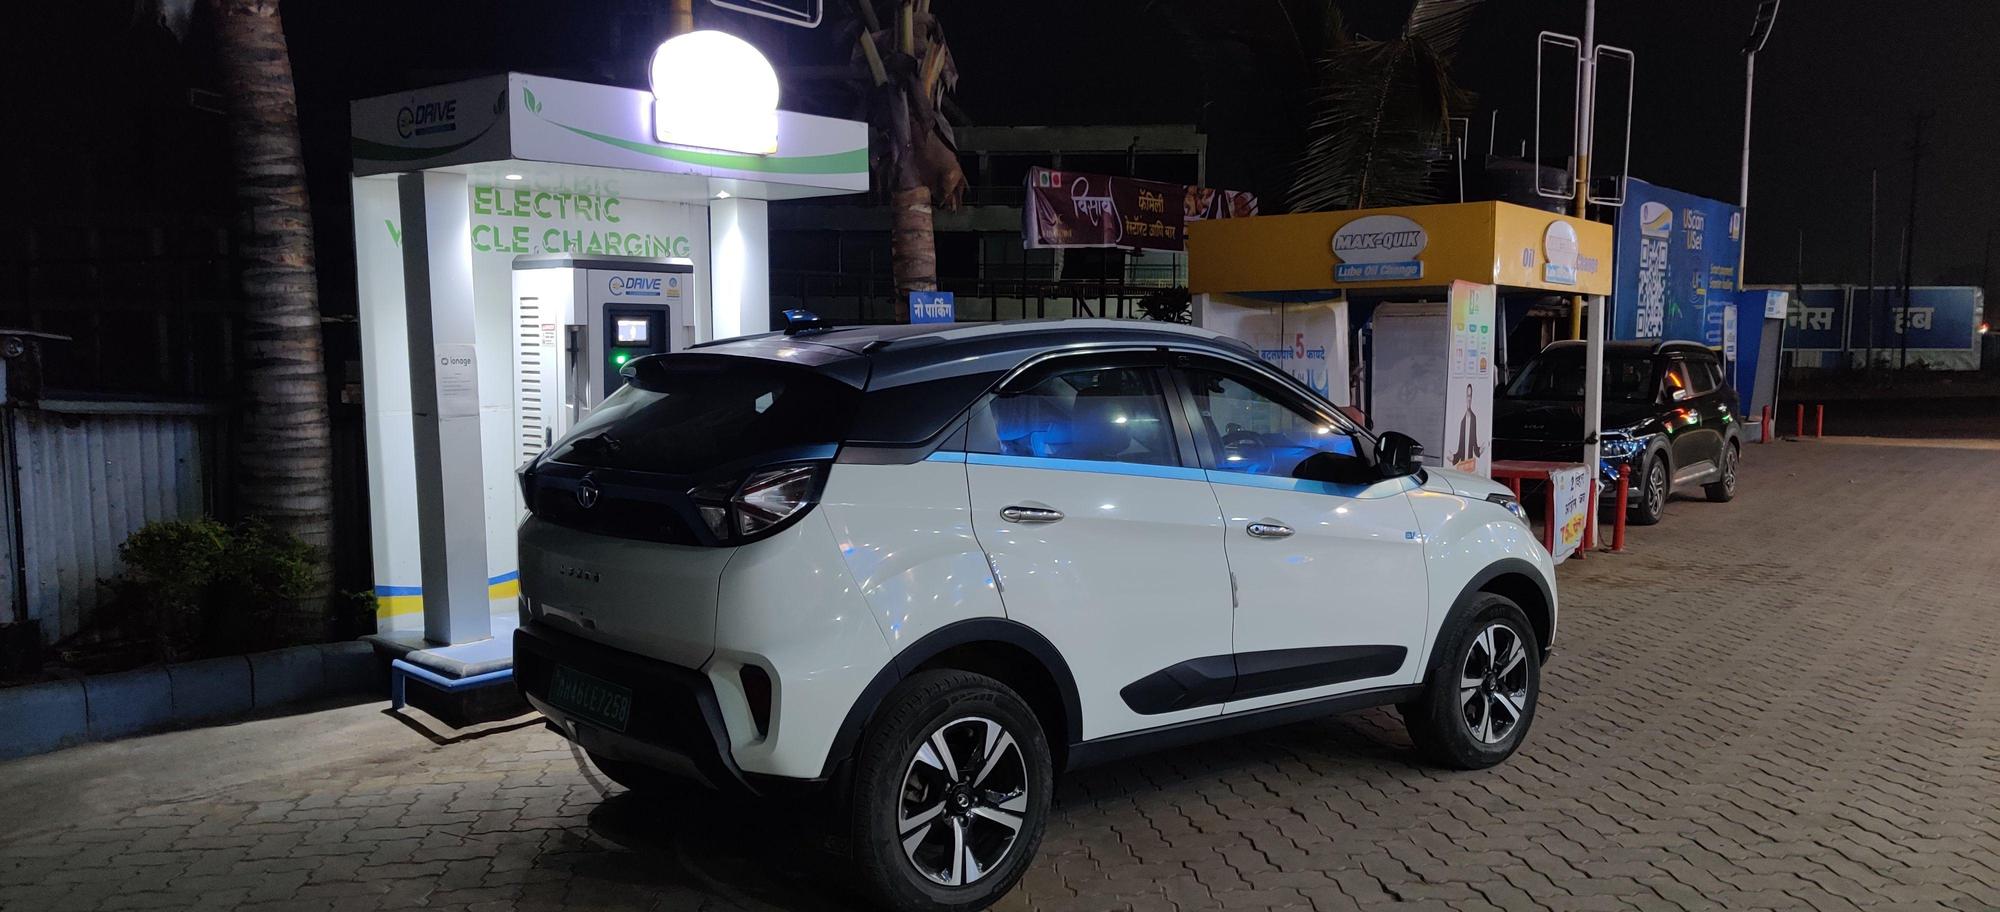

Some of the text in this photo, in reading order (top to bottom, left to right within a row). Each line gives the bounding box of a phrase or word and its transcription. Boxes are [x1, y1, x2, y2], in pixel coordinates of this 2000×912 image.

[474, 186, 621, 223] ELECTRIC
[541, 227, 691, 257] CHARGING
[913, 297, 924, 319] नो
[1295, 333, 1305, 359] 5
